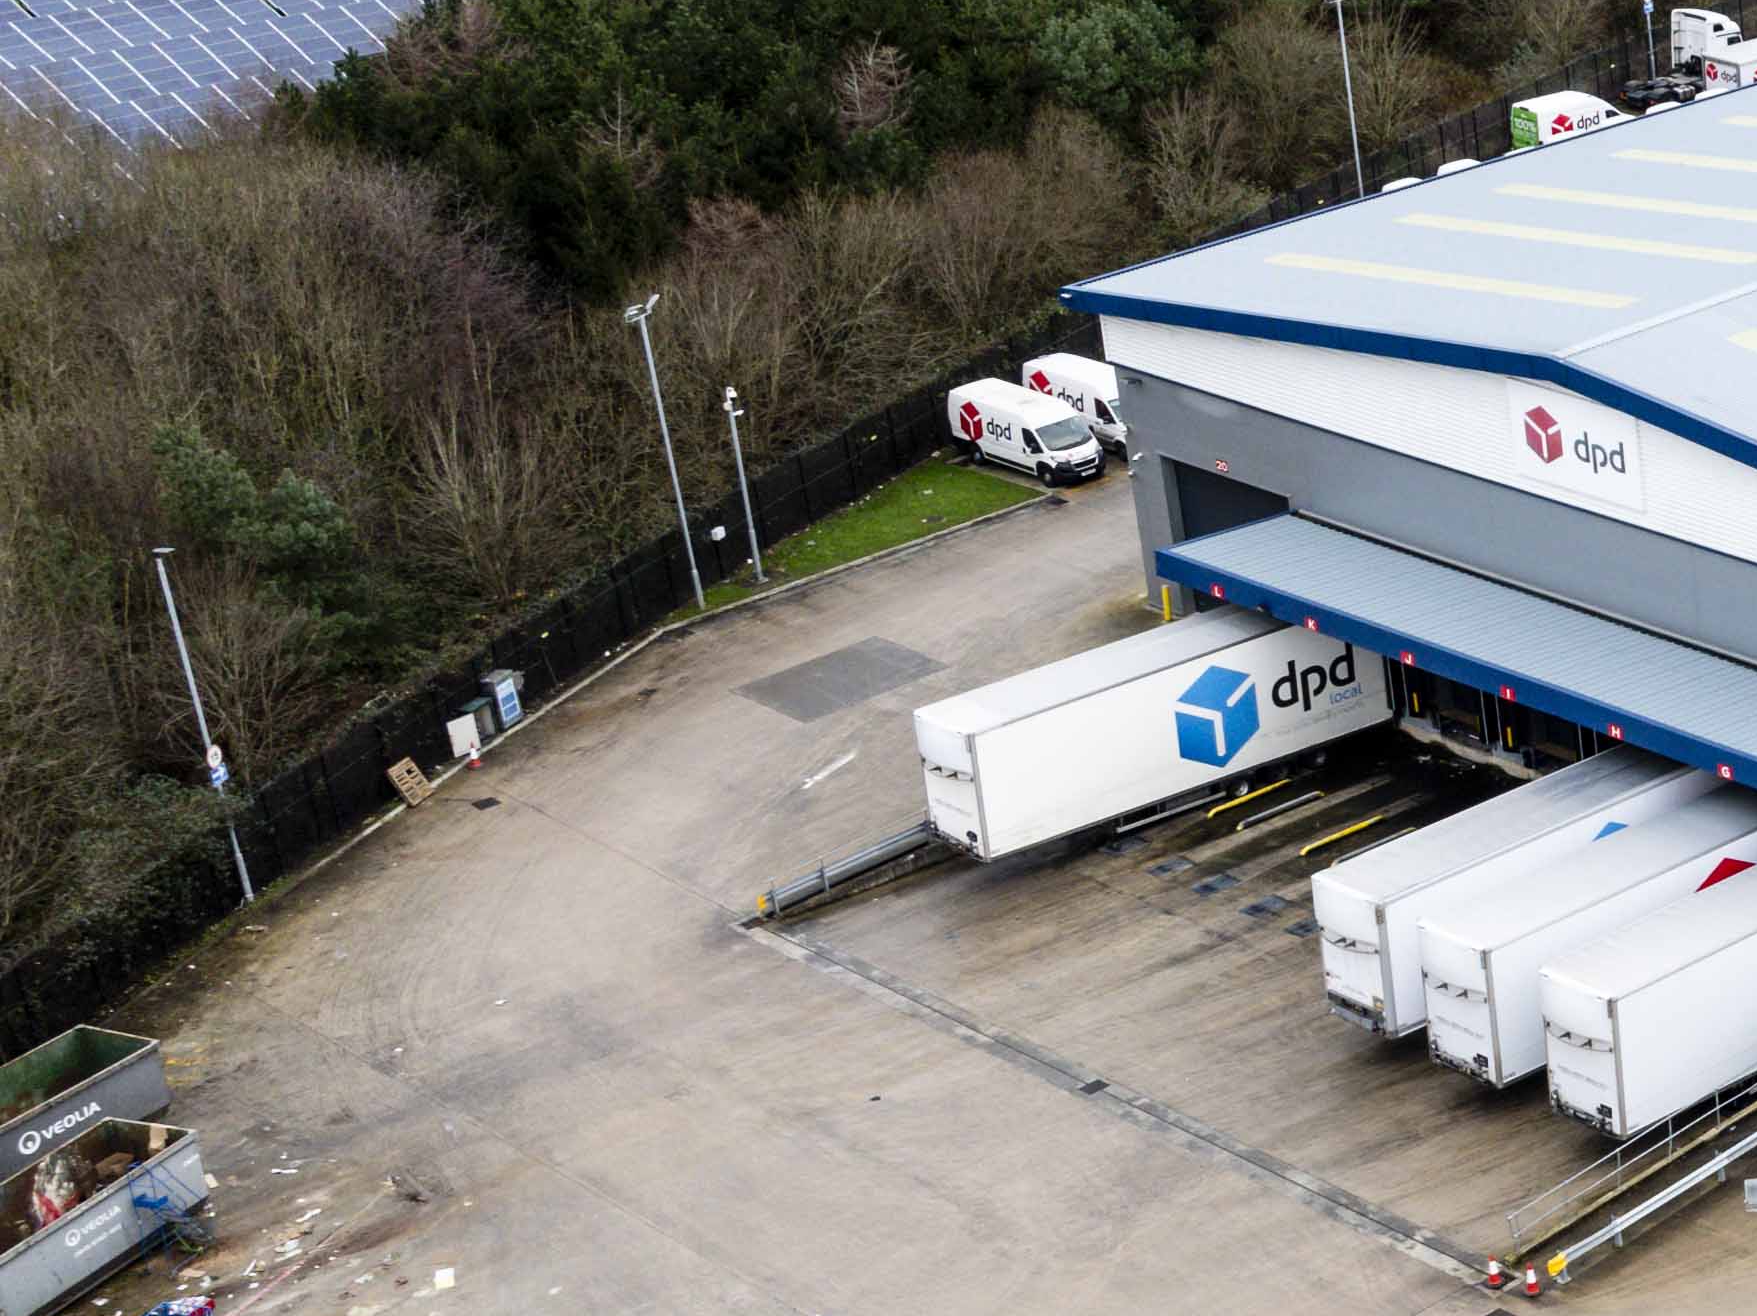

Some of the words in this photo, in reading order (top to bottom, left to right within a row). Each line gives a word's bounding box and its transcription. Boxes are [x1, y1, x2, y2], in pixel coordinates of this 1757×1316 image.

[1577, 111, 1600, 132] dpd
[1057, 388, 1084, 412] dpd
[987, 418, 1012, 441] dpd
[1574, 431, 1626, 474] dpd
[1306, 618, 1317, 630] K
[1272, 642, 1356, 712] dpd
[1329, 684, 1364, 705] local
[1611, 725, 1621, 738] H
[1720, 765, 1732, 779] G
[41, 1101, 102, 1140] VEOLIA
[79, 1205, 122, 1235] VEOLIA
